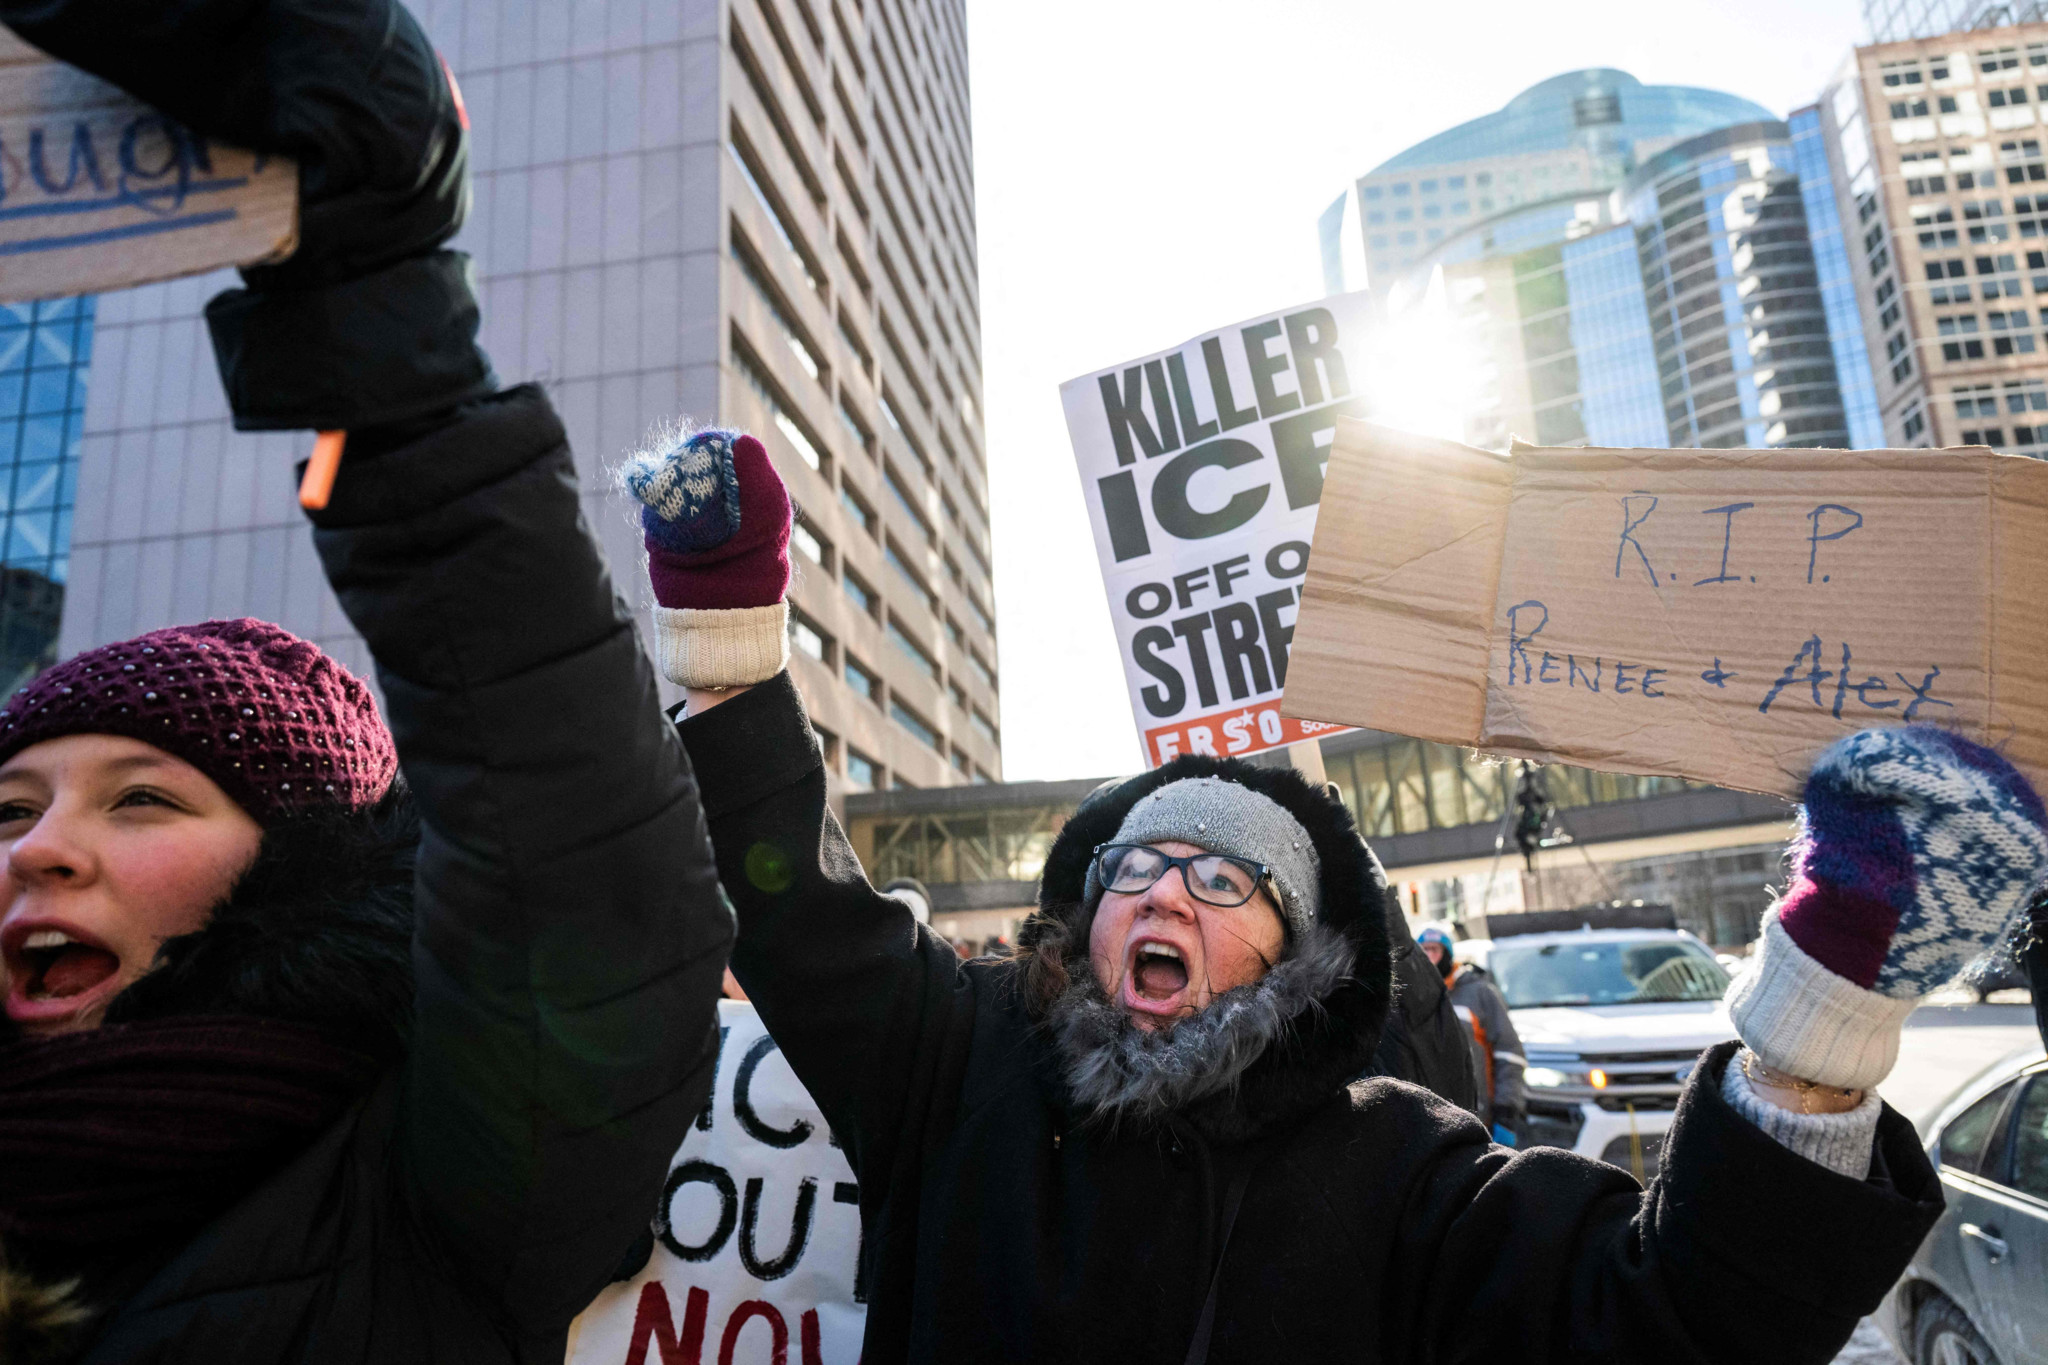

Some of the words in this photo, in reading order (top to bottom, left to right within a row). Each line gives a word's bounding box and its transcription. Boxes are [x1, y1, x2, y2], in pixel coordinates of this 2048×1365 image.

[1097, 306, 1351, 468] KILLER
[1125, 554, 1251, 619] OFF
[1265, 540, 1312, 580] O
[1614, 490, 1863, 588] R.I.P.
[1132, 583, 1304, 718] STRE
